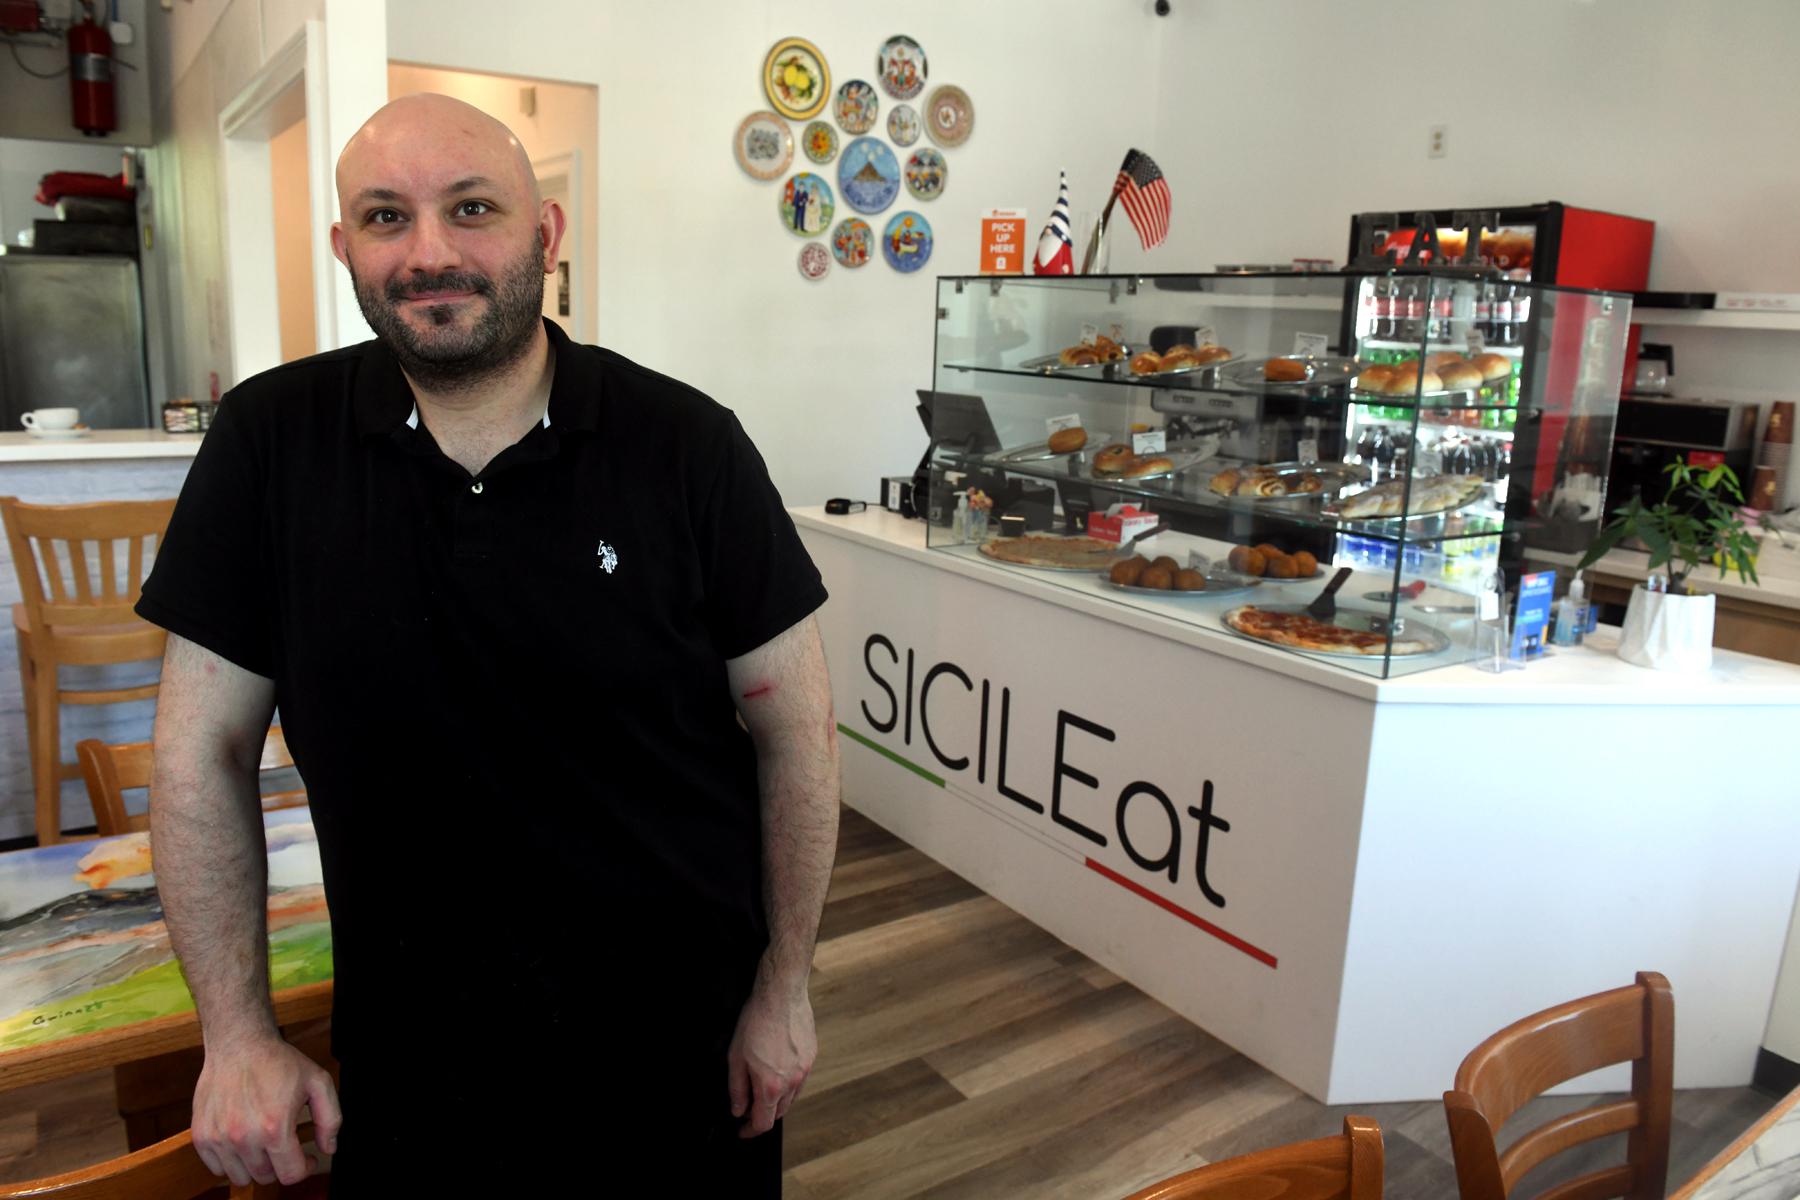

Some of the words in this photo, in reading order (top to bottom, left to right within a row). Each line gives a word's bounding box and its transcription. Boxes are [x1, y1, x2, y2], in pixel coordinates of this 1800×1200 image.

[992, 222, 1015, 232] PICK
[996, 233, 1010, 242] UP
[1357, 210, 1499, 268] EAT
[990, 244, 1015, 253] HERE
[861, 633, 1231, 909] SICILEat
